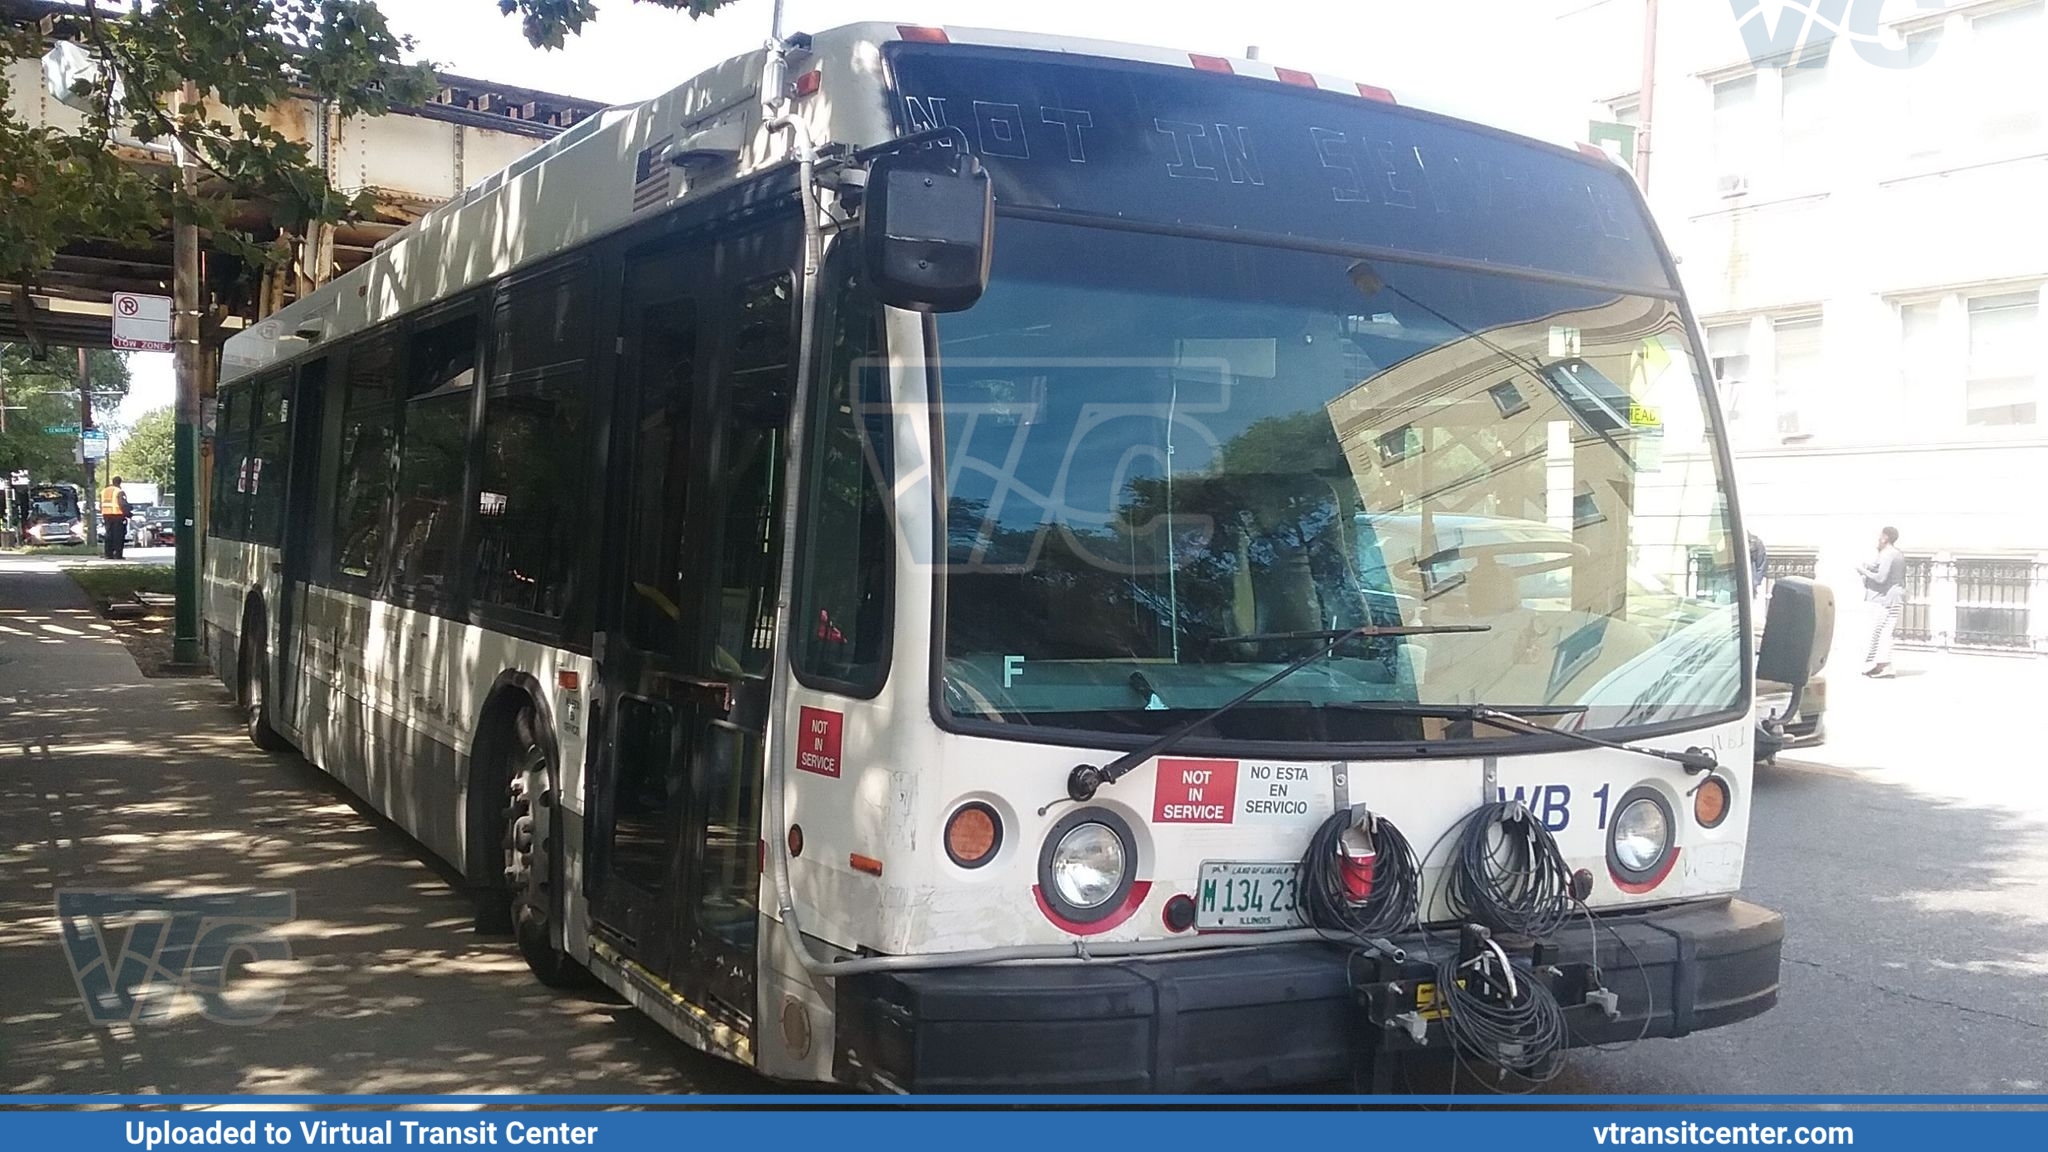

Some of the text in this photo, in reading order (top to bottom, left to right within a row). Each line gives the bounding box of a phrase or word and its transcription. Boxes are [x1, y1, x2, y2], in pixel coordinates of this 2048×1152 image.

[905, 95, 1094, 163] NOT
[1153, 117, 1265, 186] IN
[117, 339, 167, 350] TOW ZONE
[1003, 655, 1025, 688] F
[811, 719, 828, 735] NOT
[814, 737, 823, 751] IN
[801, 751, 835, 772] SERVICE
[1182, 770, 1212, 785] NOT
[1250, 766, 1309, 781] NO ESTA
[1188, 788, 1203, 802] IN
[1269, 783, 1288, 797] EN
[1163, 804, 1225, 820] SERVICE
[1245, 800, 1308, 815] SERVICIO
[1202, 879, 1217, 912] M
[1222, 878, 1263, 912] 134
[1240, 916, 1272, 925] ILLINOIS
